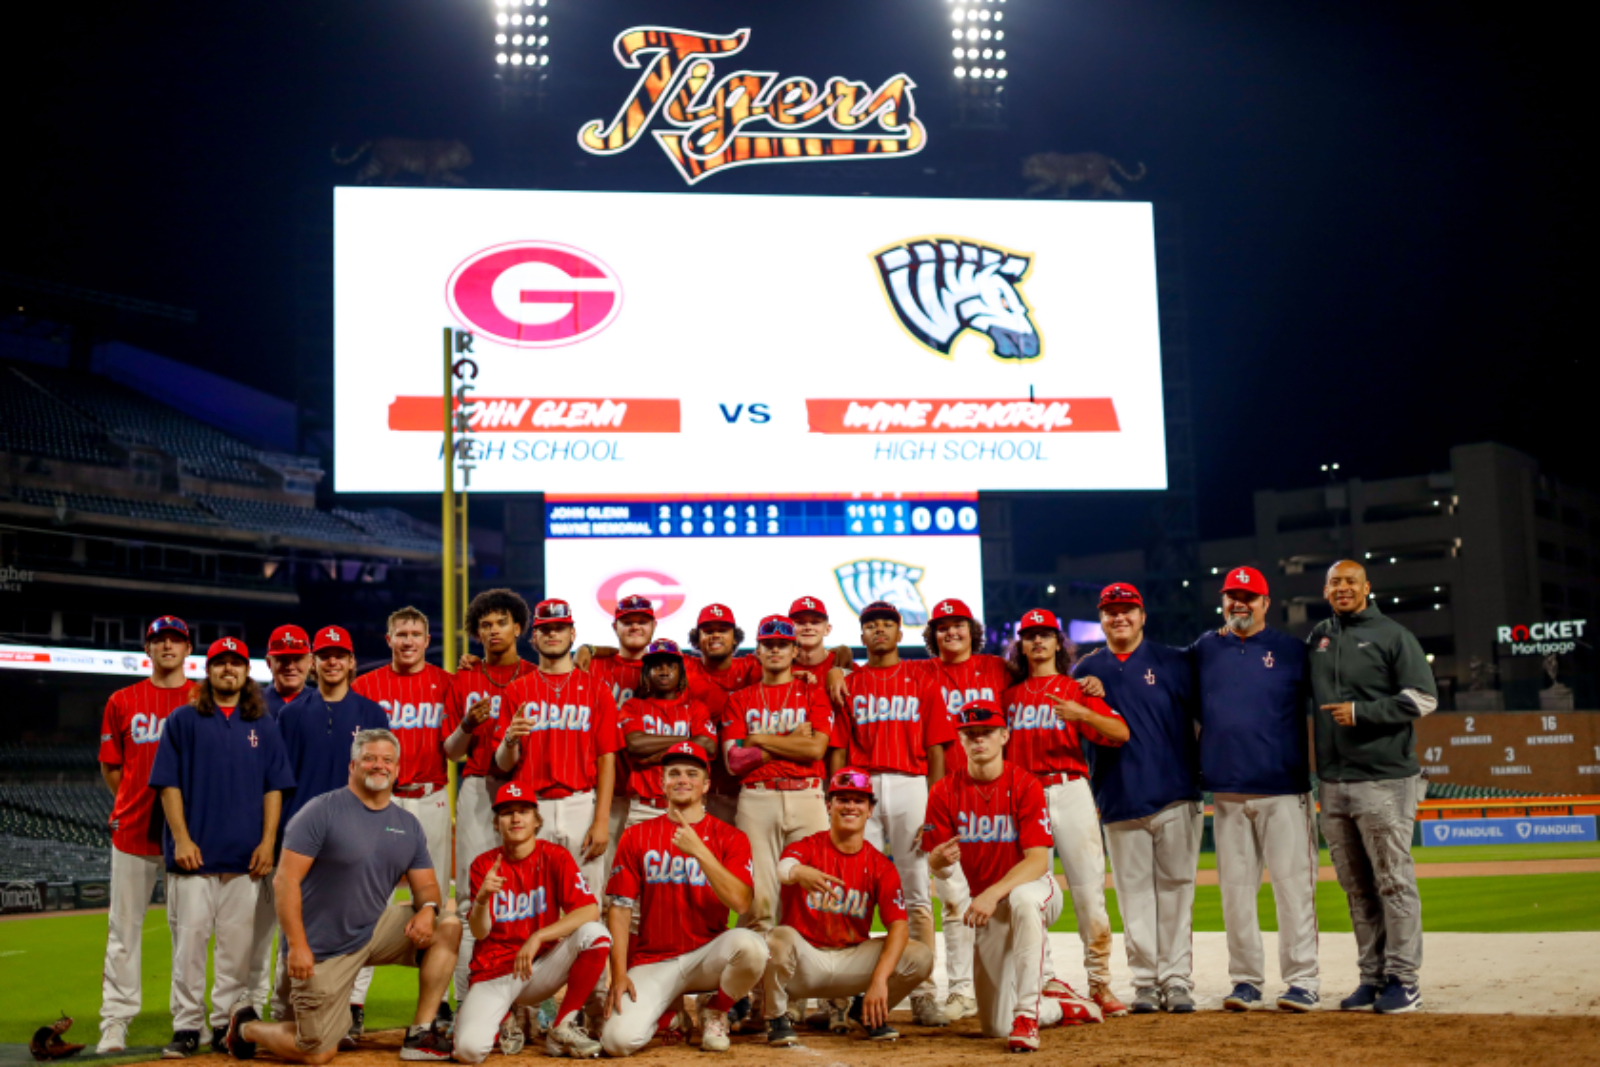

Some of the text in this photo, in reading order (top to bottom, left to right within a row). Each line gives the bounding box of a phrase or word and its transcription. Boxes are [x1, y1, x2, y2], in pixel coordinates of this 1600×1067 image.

[577, 26, 927, 185] Tigers
[451, 244, 619, 345] G
[531, 400, 628, 428] GLENN
[719, 403, 771, 423] VS
[511, 440, 625, 461] SCHOOL
[873, 440, 1049, 461] HIGH SCHOOL
[550, 505, 586, 519] JOHN
[586, 505, 630, 519] GLENN
[681, 505, 693, 519] 0
[703, 505, 713, 519] 1
[724, 505, 735, 519] 4
[746, 505, 756, 519] 1
[847, 504, 865, 518] 11
[868, 504, 886, 518] 11
[893, 504, 903, 518] 1
[911, 506, 978, 531] 0 0 0
[550, 521, 591, 535] WAYNE
[592, 521, 653, 535] MEMORIAL
[659, 521, 671, 535] 0
[681, 521, 693, 535] 0
[703, 521, 715, 535] 0
[724, 521, 736, 535] 0
[851, 519, 863, 533] 4
[1497, 619, 1587, 643] ROCKET
[1511, 641, 1576, 656] Mortgage
[524, 701, 591, 733] Glenn
[853, 693, 920, 725] Glenn
[1465, 717, 1475, 732] 2
[1541, 716, 1558, 731] 16
[1424, 746, 1442, 762] 47
[1504, 746, 1515, 762] 3
[1452, 826, 1504, 838] FANDUEL
[1534, 824, 1586, 836] FANDUEL
